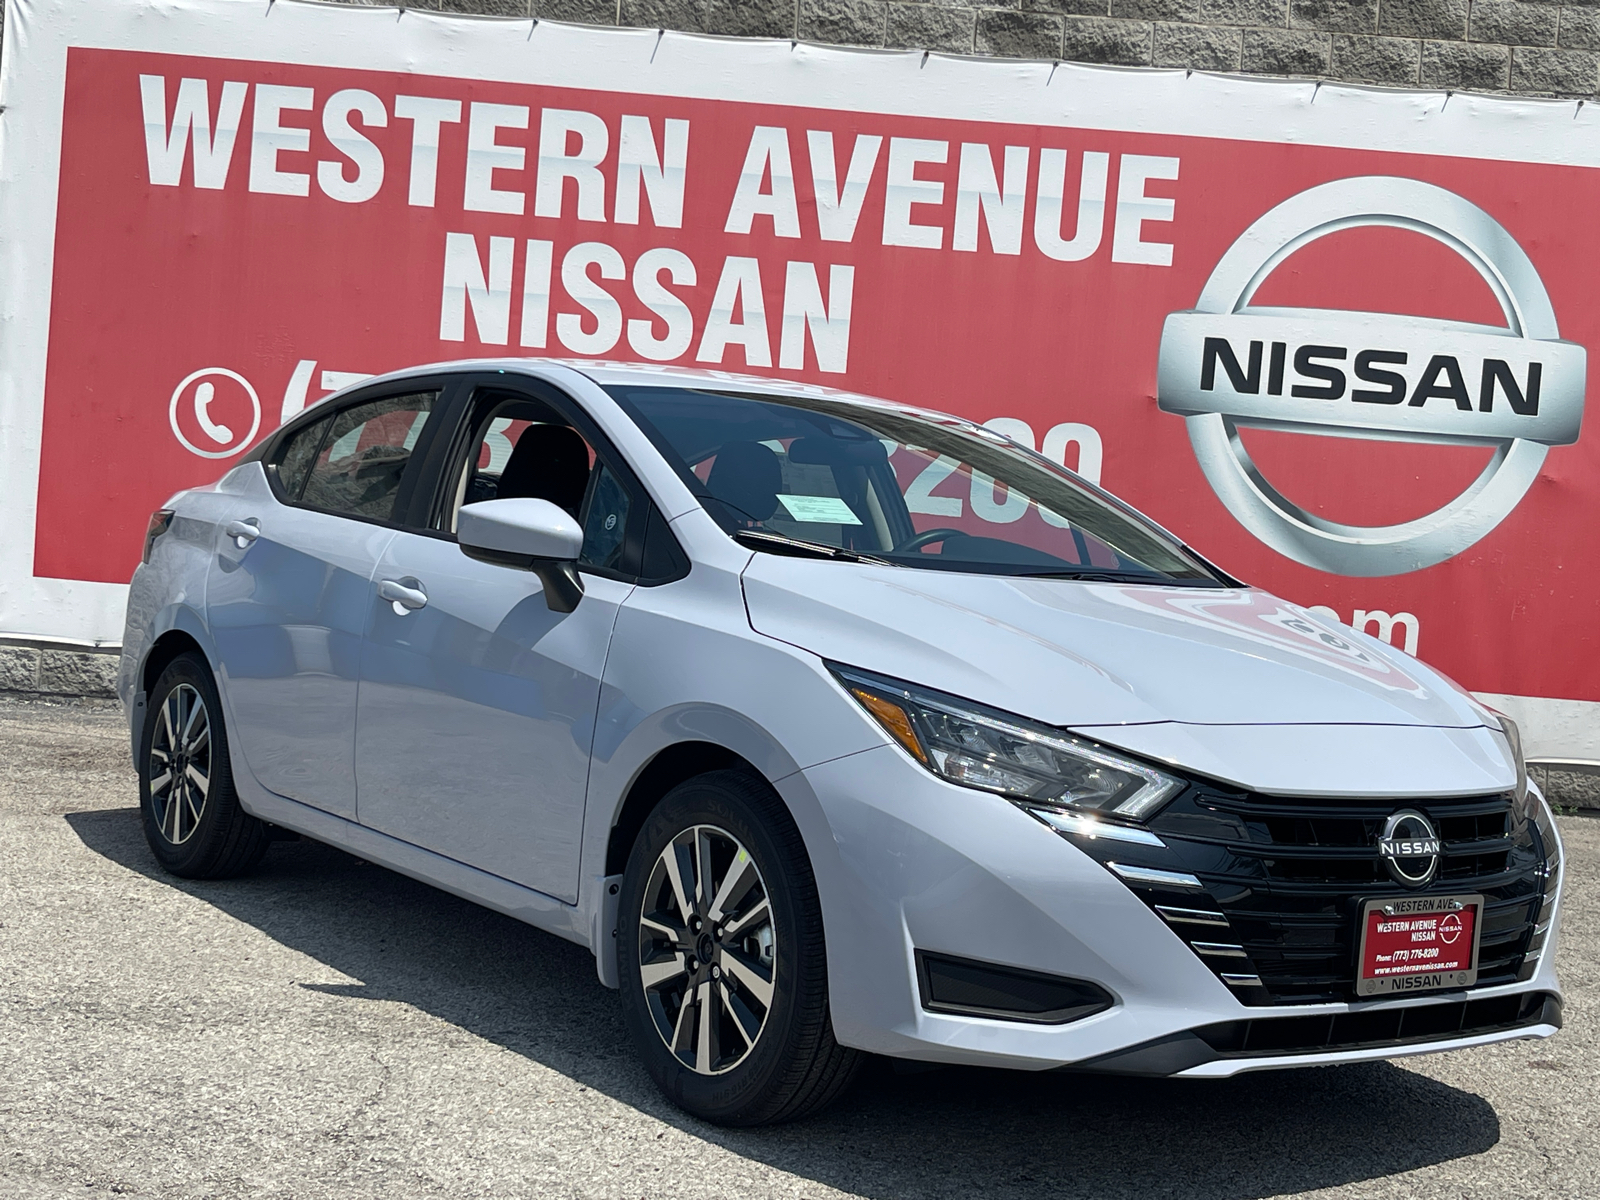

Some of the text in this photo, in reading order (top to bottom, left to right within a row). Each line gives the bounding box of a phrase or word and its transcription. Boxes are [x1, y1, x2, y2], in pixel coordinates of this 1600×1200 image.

[140, 74, 1180, 267] WESTERN AVENUE
[440, 232, 855, 373] NISSAN
[1200, 337, 1543, 416] NISSAN
[1381, 841, 1440, 855] NISSAN
[1393, 899, 1435, 912] WESTERN
[1377, 919, 1437, 933] WESTERN AVENUE
[1411, 931, 1436, 942] NISSAN
[1392, 950, 1410, 963] (773)
[1410, 947, 1439, 960] 776-8200
[1374, 961, 1458, 975] www.westernavenissan.com
[1391, 974, 1441, 990] NISSAN
